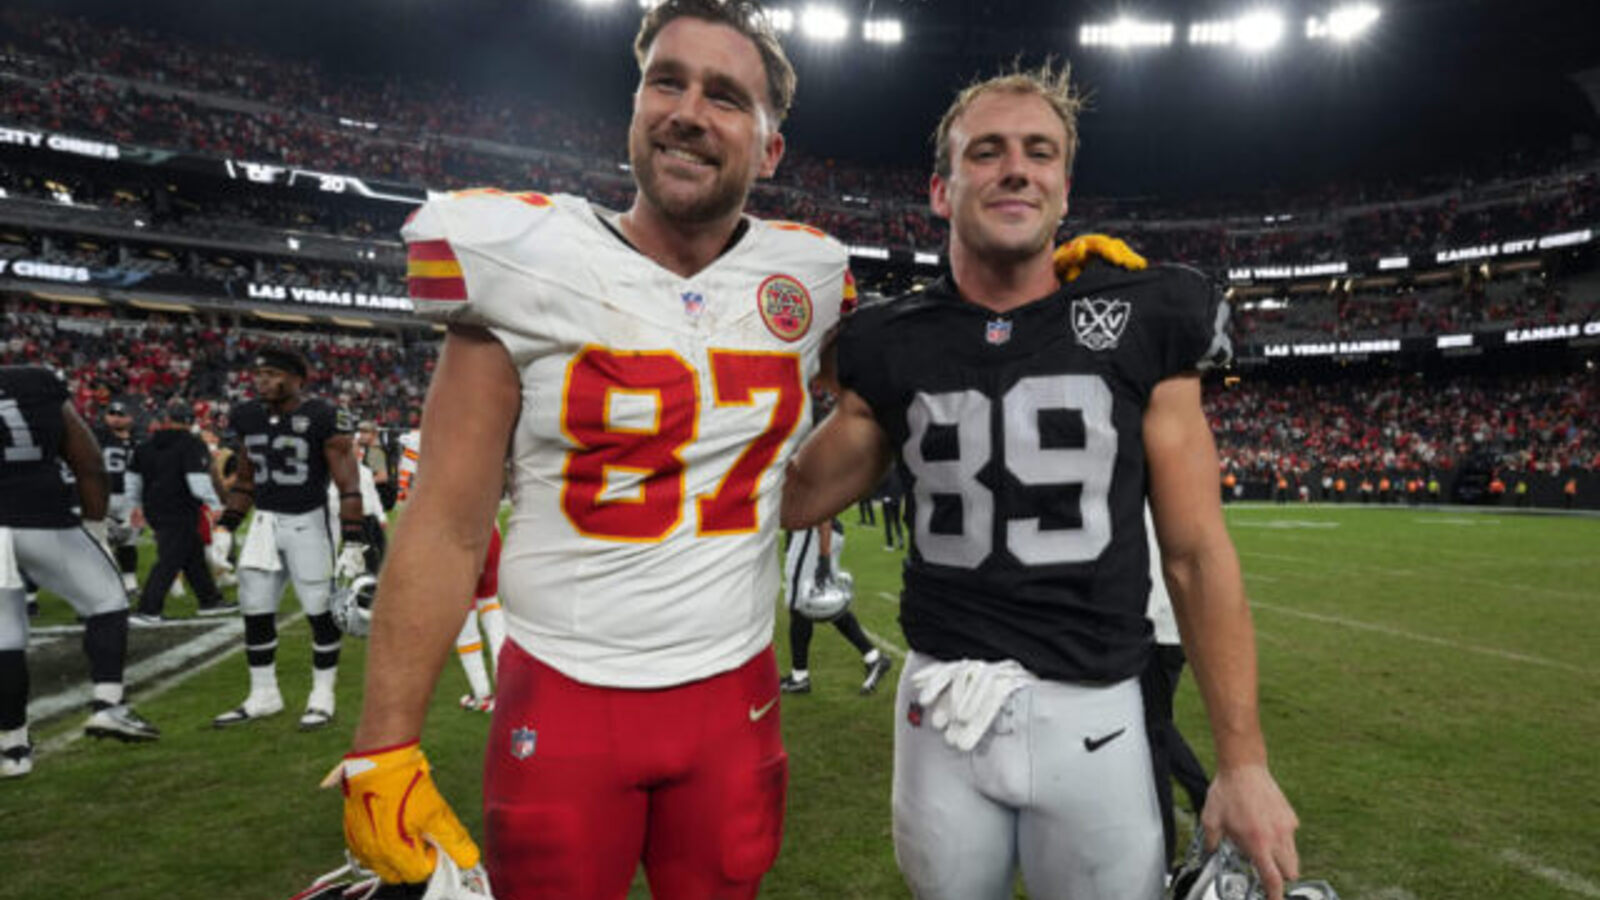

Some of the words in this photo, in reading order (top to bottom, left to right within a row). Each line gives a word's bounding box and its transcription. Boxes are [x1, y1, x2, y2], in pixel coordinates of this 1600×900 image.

[248, 284, 286, 299] LAS
[290, 288, 352, 305] VEGAS
[1505, 325, 1579, 342] KANSAS
[244, 434, 309, 485] 53
[561, 344, 804, 543] 87
[903, 374, 1117, 569] 89
